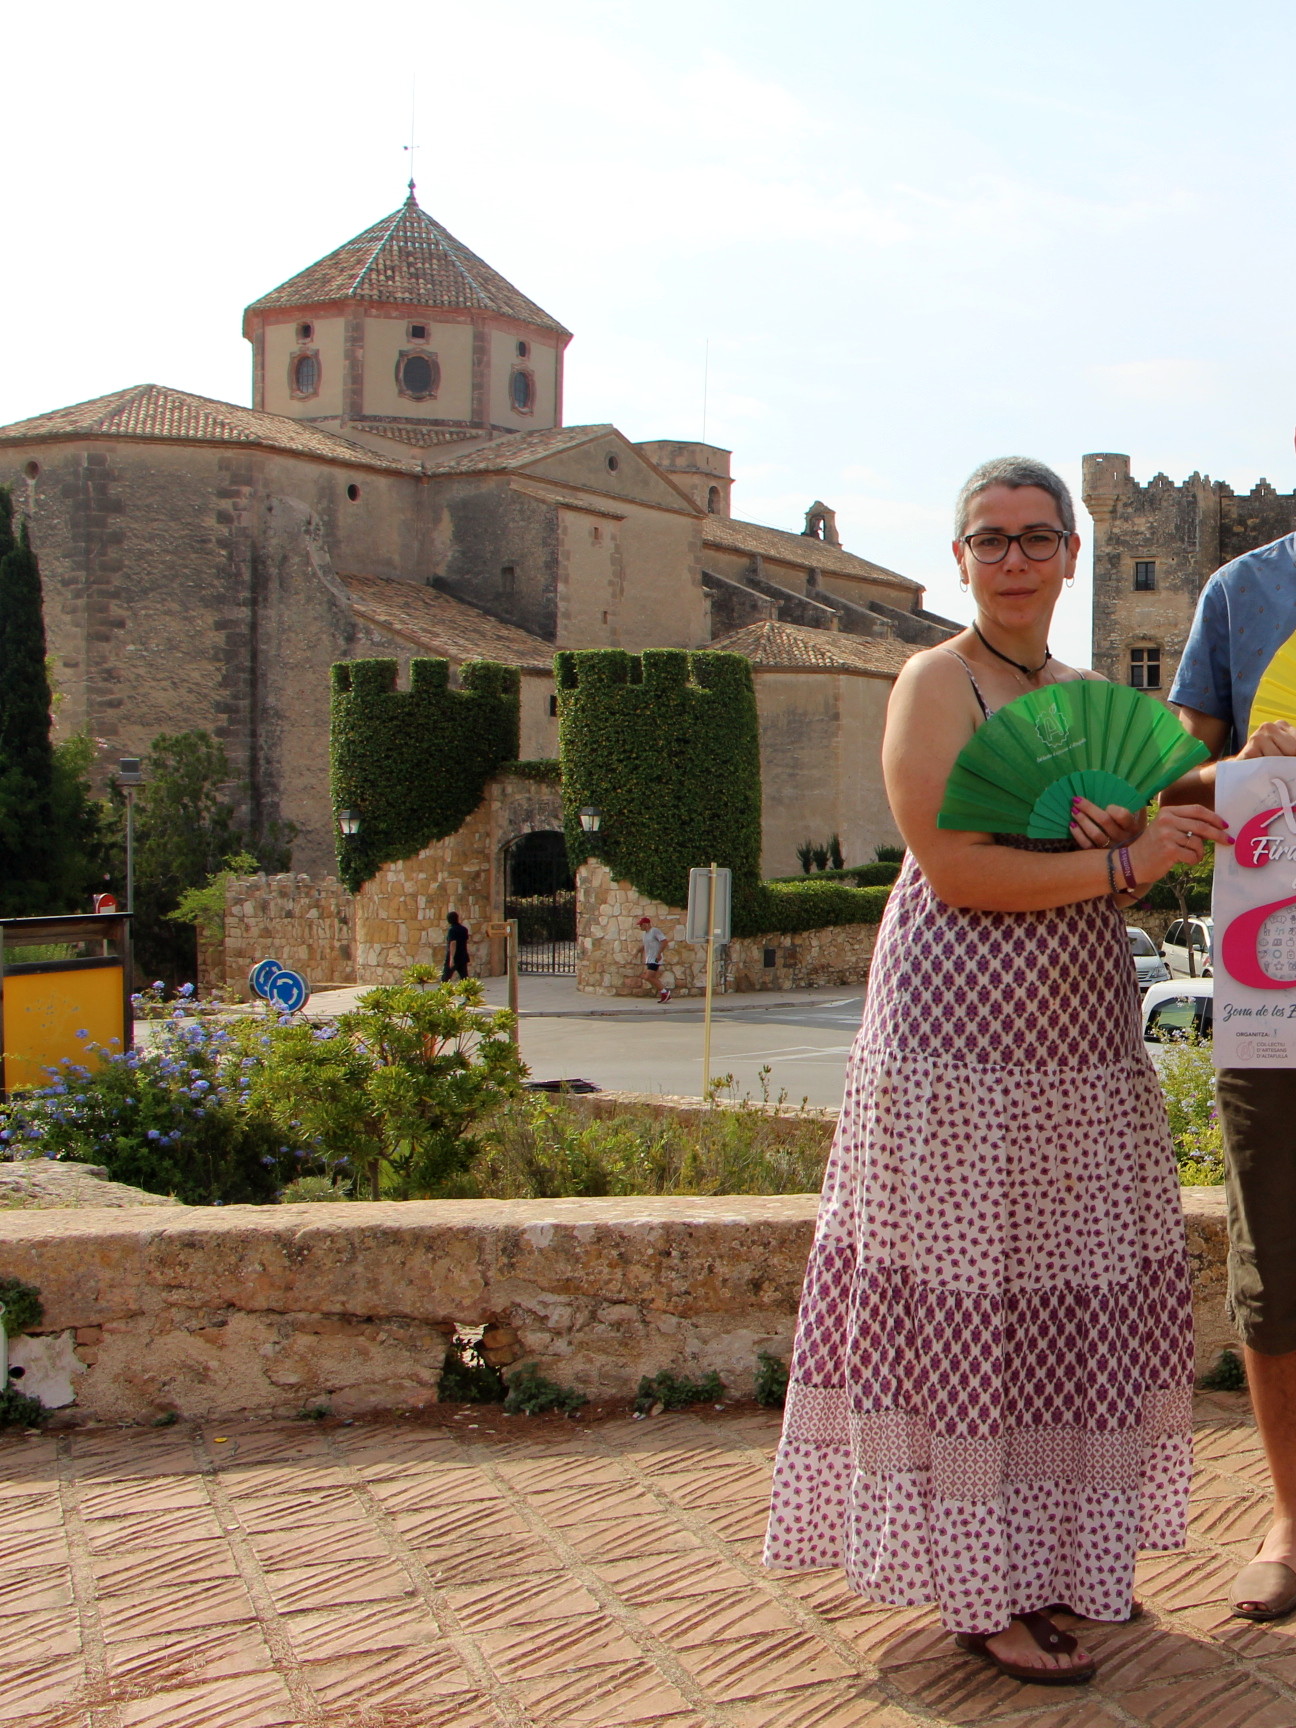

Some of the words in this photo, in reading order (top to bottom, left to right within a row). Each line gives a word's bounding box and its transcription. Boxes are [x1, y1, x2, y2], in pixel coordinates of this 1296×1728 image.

[1222, 1003, 1253, 1022] Zona
[1255, 1005, 1269, 1017] de
[1271, 1005, 1286, 1017] les
